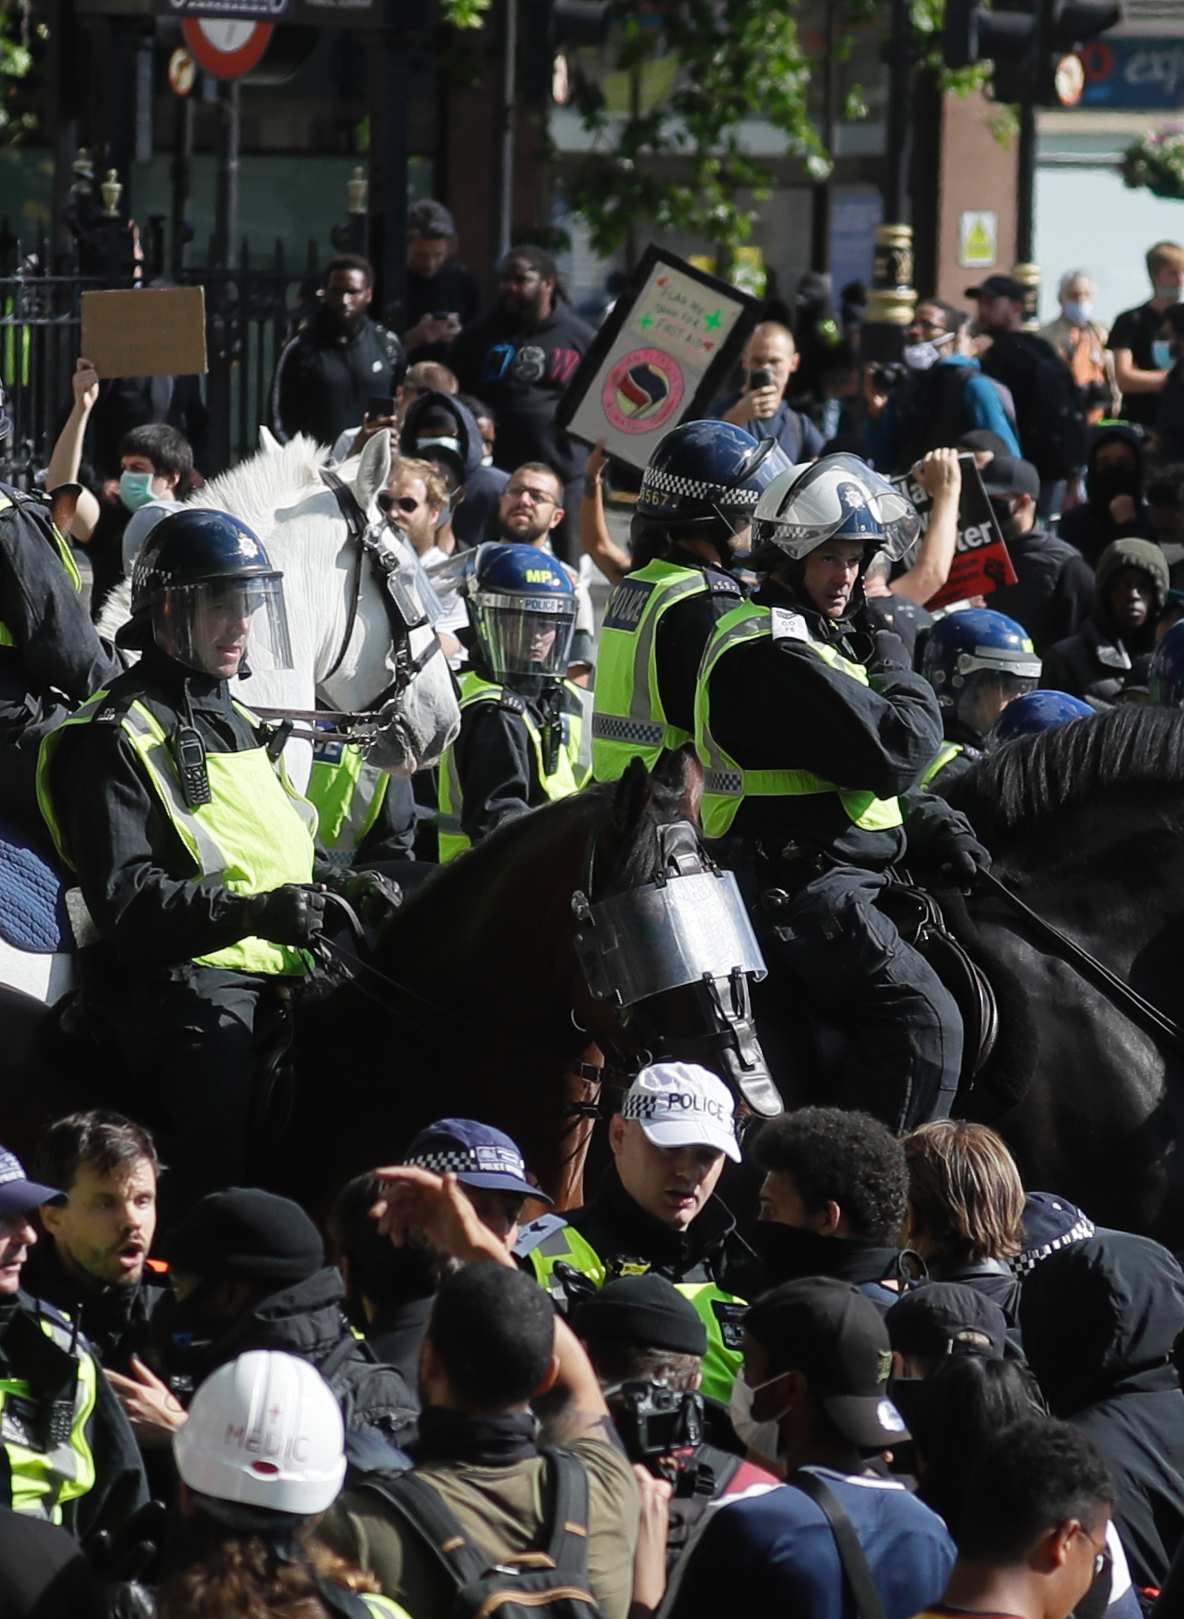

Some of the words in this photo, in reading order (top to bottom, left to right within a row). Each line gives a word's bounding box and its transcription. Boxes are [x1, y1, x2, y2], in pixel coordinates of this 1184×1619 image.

[525, 599, 556, 611] POLICE
[667, 1092, 724, 1122] POLICE
[223, 1422, 309, 1463] MEDIC
